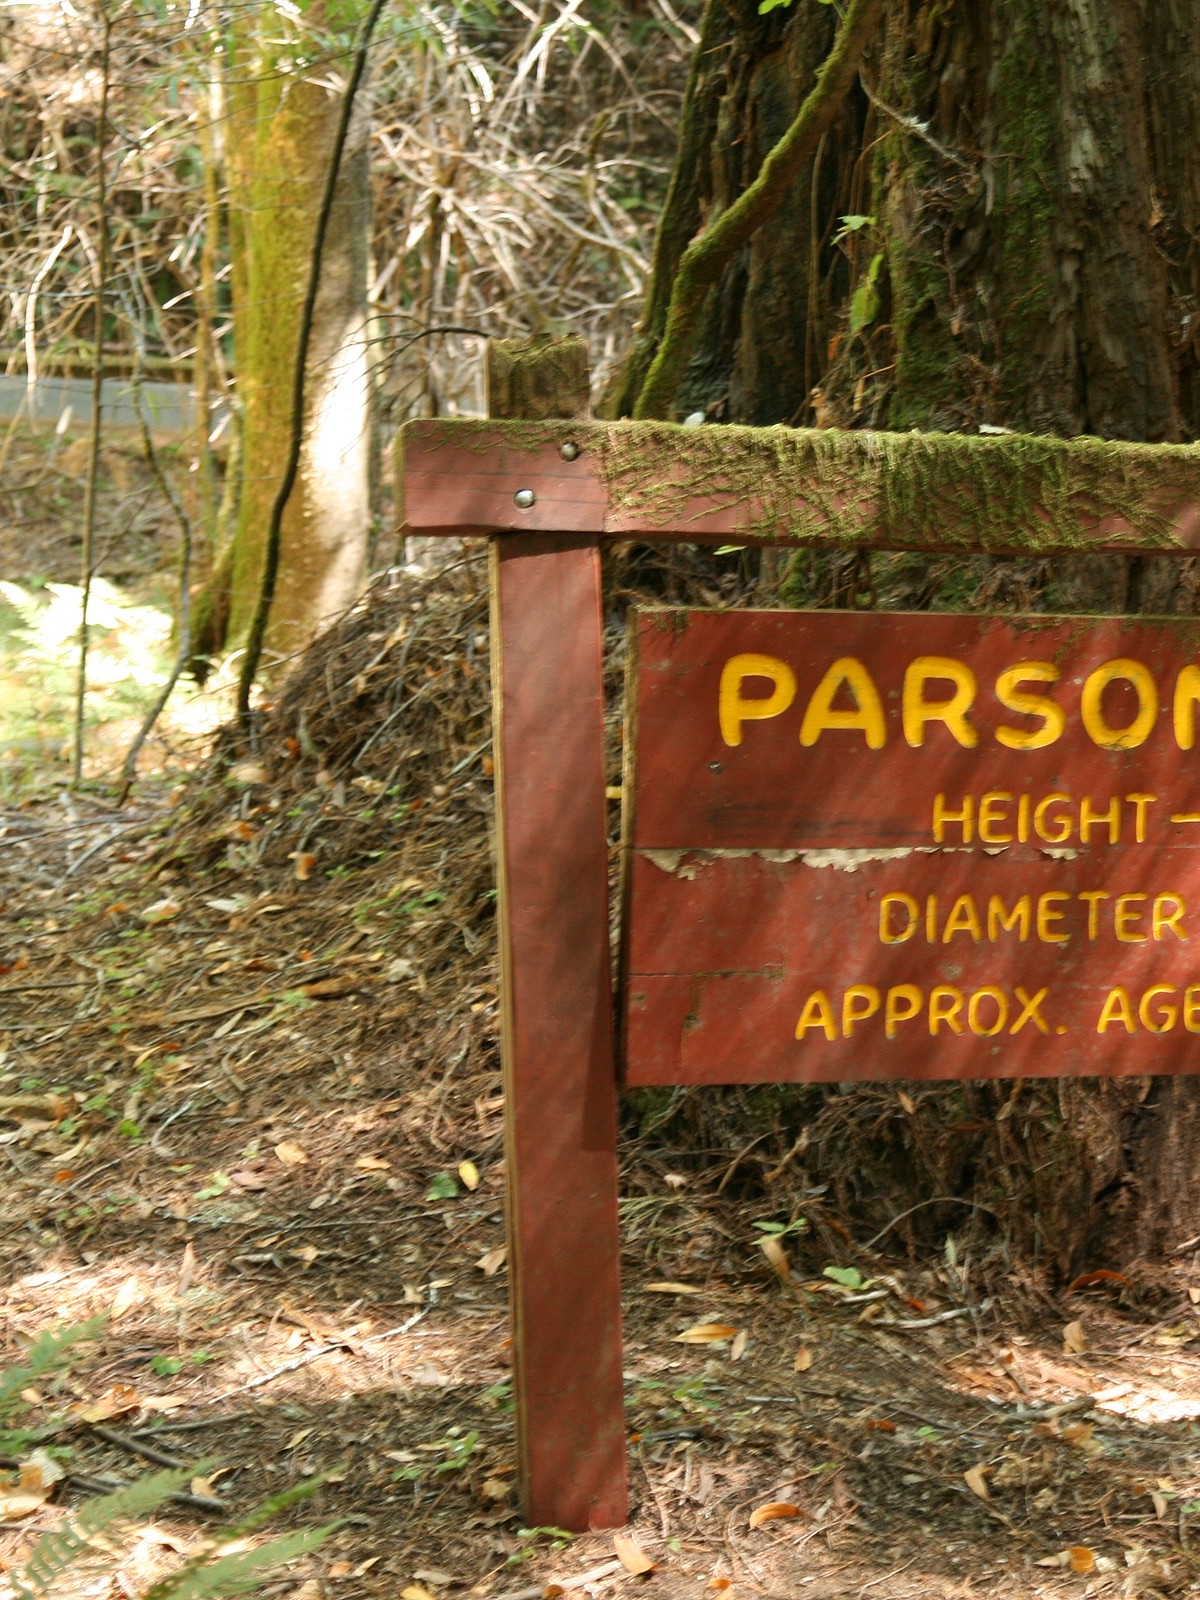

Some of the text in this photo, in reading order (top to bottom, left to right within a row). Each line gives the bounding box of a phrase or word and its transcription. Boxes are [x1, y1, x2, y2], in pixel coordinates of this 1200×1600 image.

[932, 790, 1159, 845] HEIGHT
[878, 889, 1189, 946] DIAMETER
[794, 983, 1069, 1041] APPROX.
